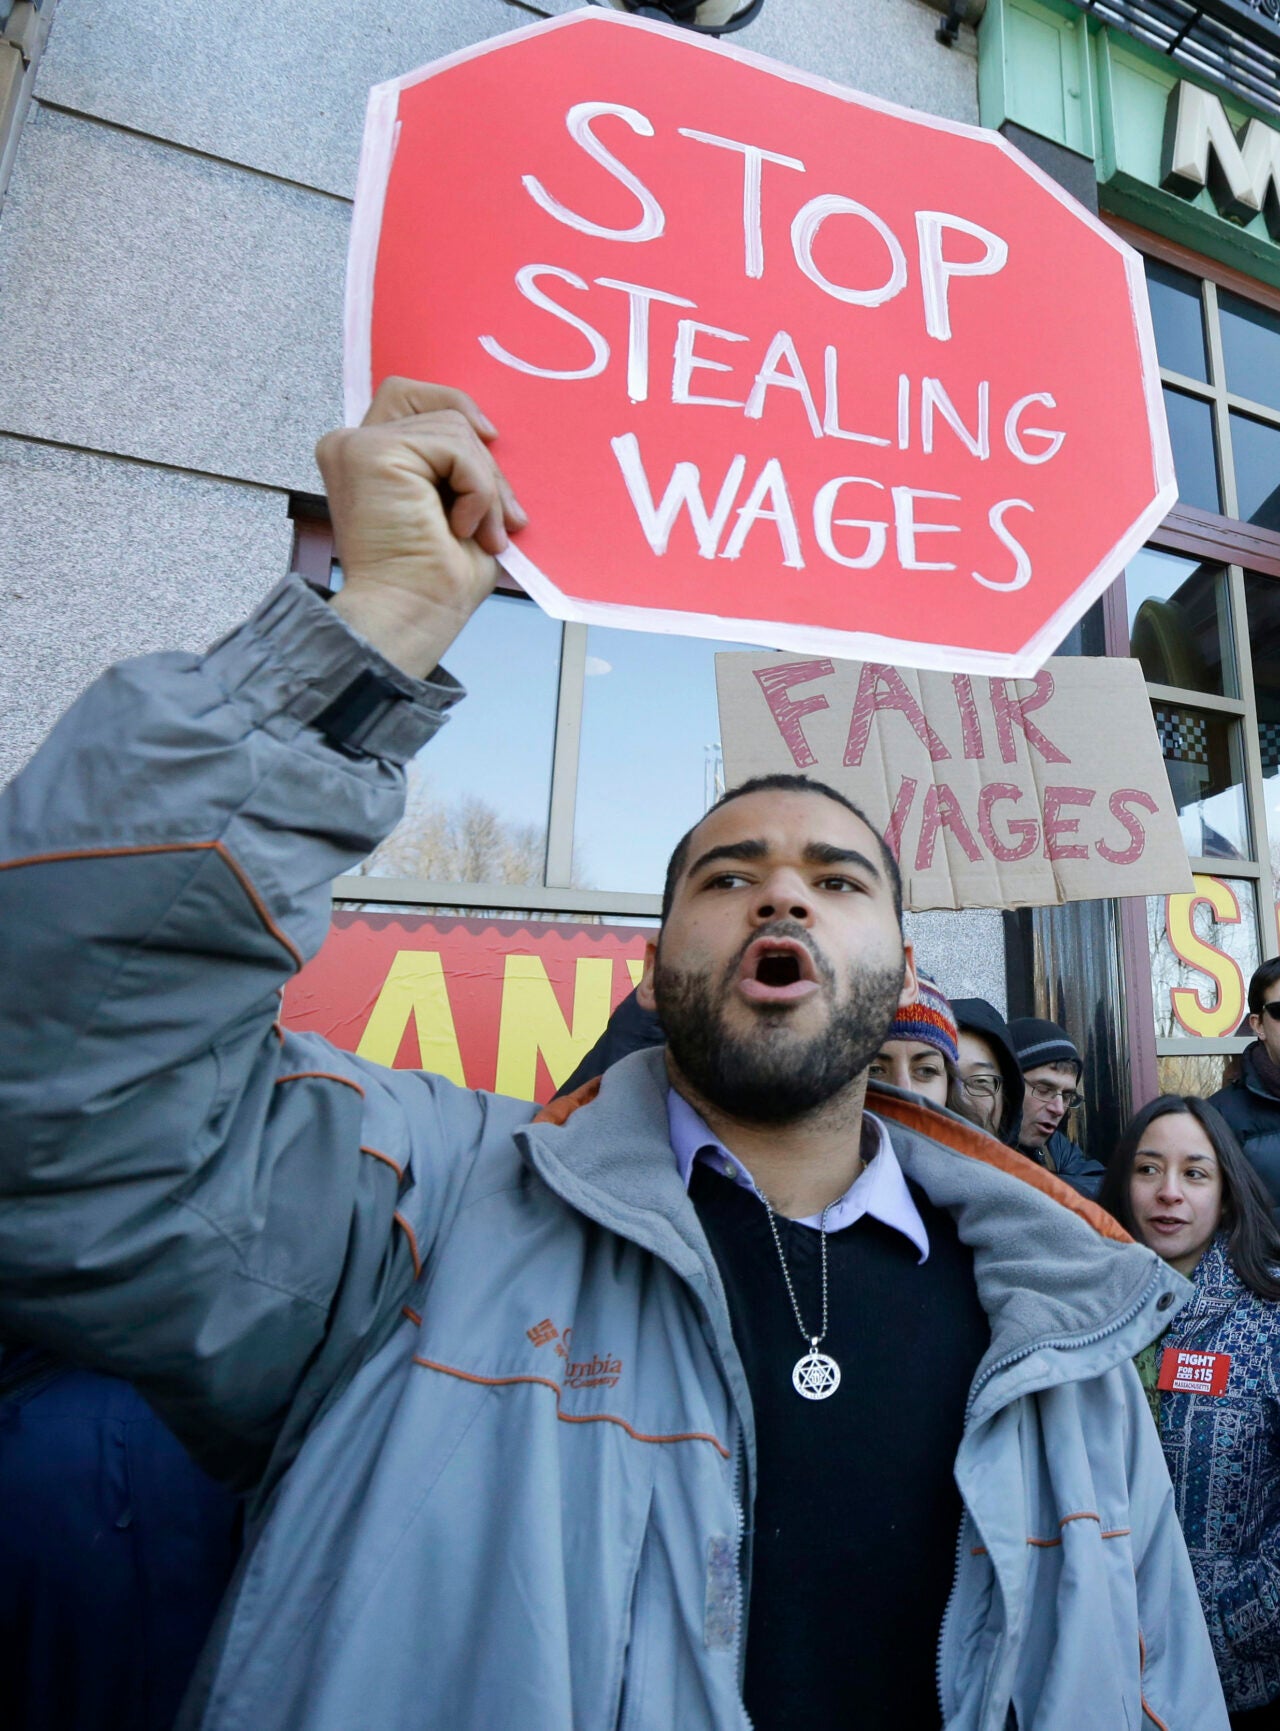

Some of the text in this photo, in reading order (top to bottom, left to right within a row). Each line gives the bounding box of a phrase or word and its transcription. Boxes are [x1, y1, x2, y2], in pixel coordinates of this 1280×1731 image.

[521, 101, 1009, 341] STOP
[477, 263, 1067, 465] STEALING
[610, 432, 1035, 592] WAGES
[752, 658, 1072, 769] FAIR
[355, 949, 644, 1103] AN
[1177, 1353, 1216, 1367] FIGHT
[1178, 1366, 1214, 1382] FOR $15
